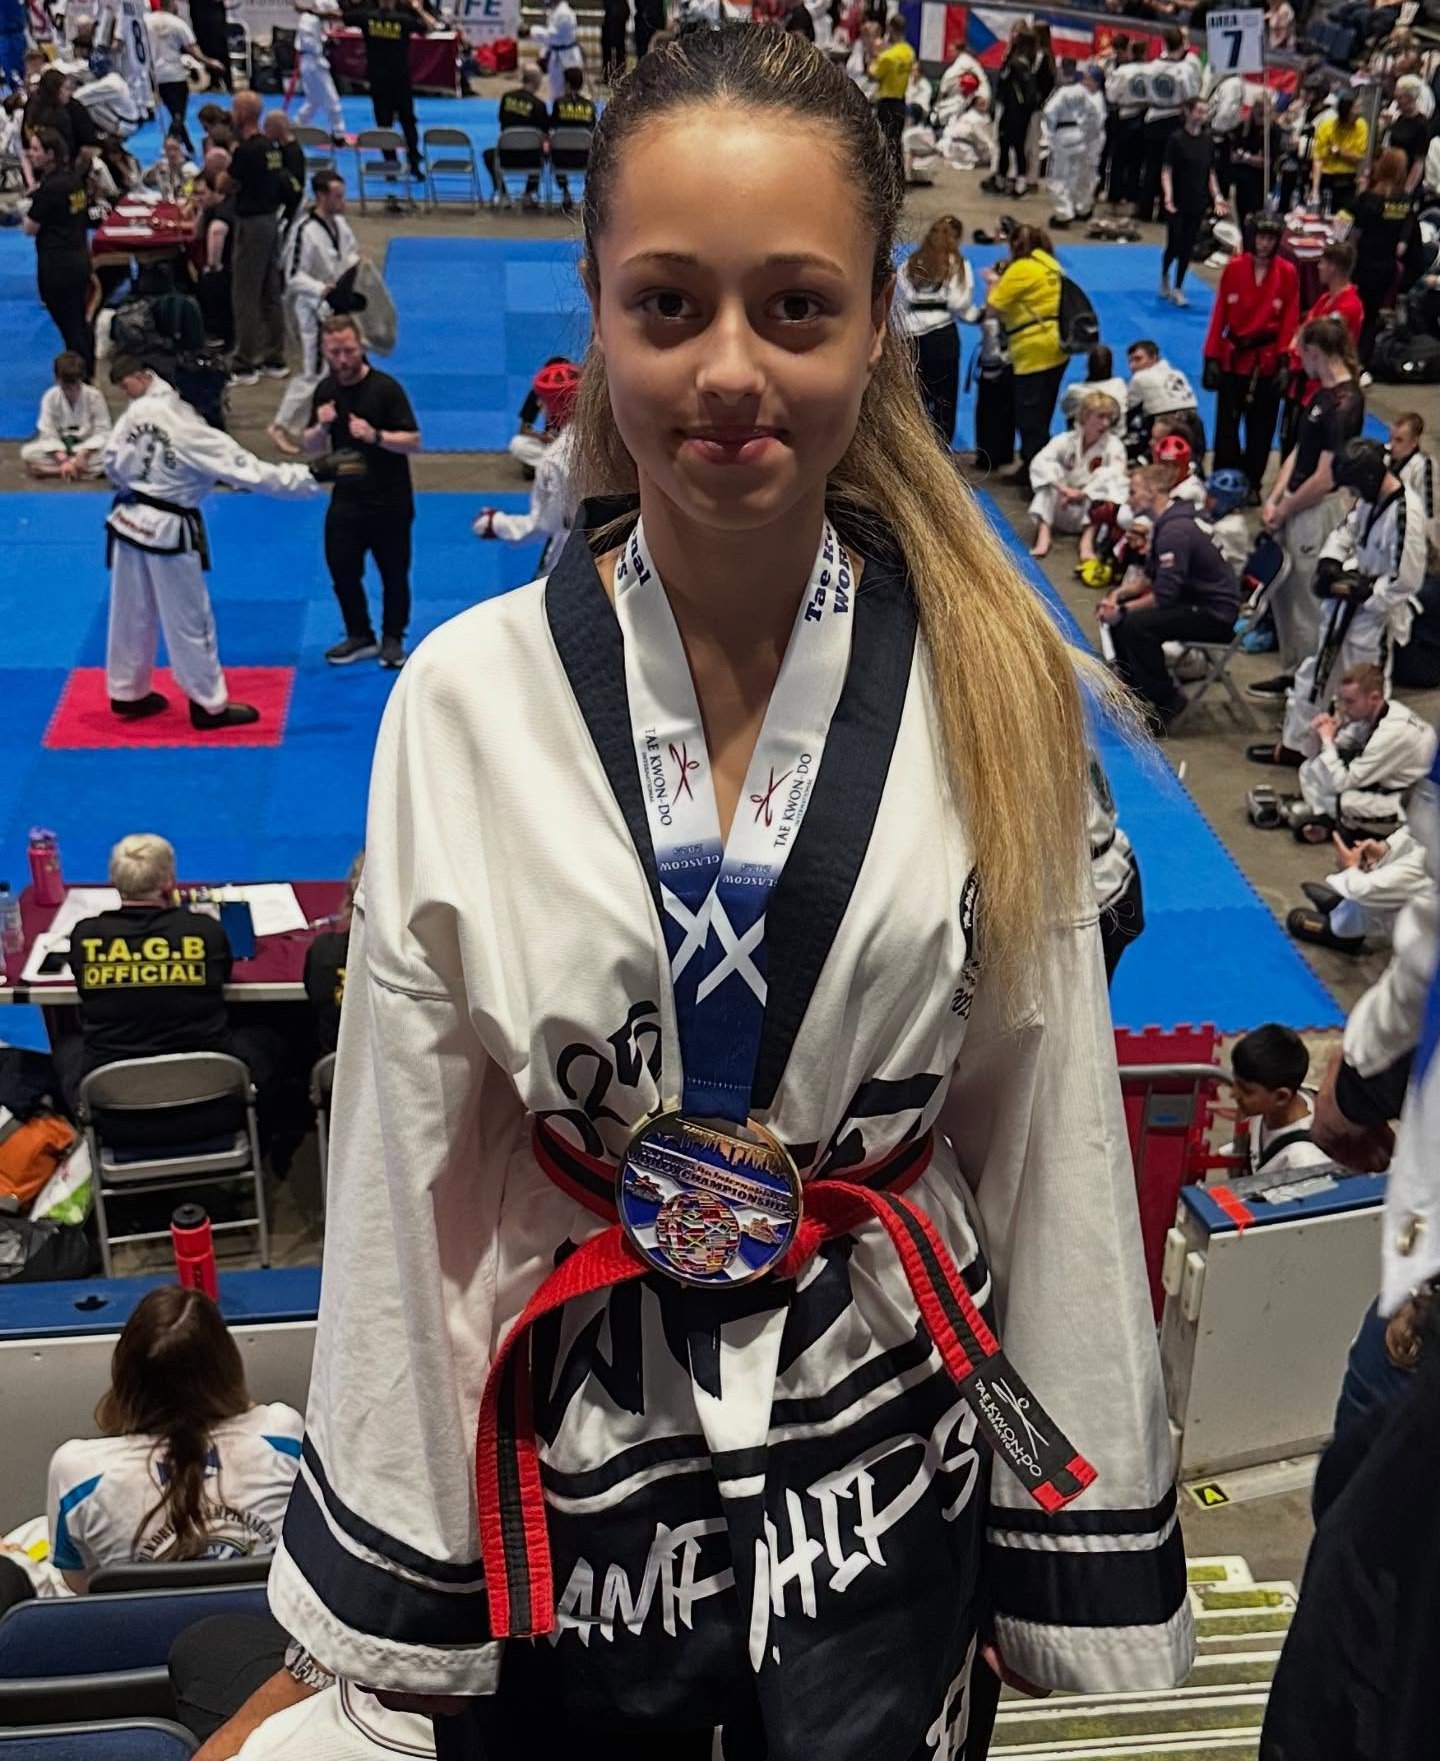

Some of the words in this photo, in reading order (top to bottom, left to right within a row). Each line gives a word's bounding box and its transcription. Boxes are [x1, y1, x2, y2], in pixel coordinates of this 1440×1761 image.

[132, 19, 146, 64] 8
[1222, 30, 1243, 68] 7
[804, 569, 831, 622] Tae
[833, 535, 850, 614] WOR
[645, 728, 660, 752] TAE
[650, 755, 673, 826] KWON-DO
[773, 824, 792, 848] TAE
[783, 753, 813, 822] KWON-DO
[660, 854, 721, 872] GLASGOW
[81, 936, 206, 963] T.A.G.B
[85, 964, 204, 985] OFFICIAL
[678, 1168, 798, 1220] CHAMPIONSHIPS
[975, 1378, 992, 1404] TAE
[987, 1401, 1042, 1477] KWON-DO
[979, 1398, 1021, 1465] INTERNATIONAL
